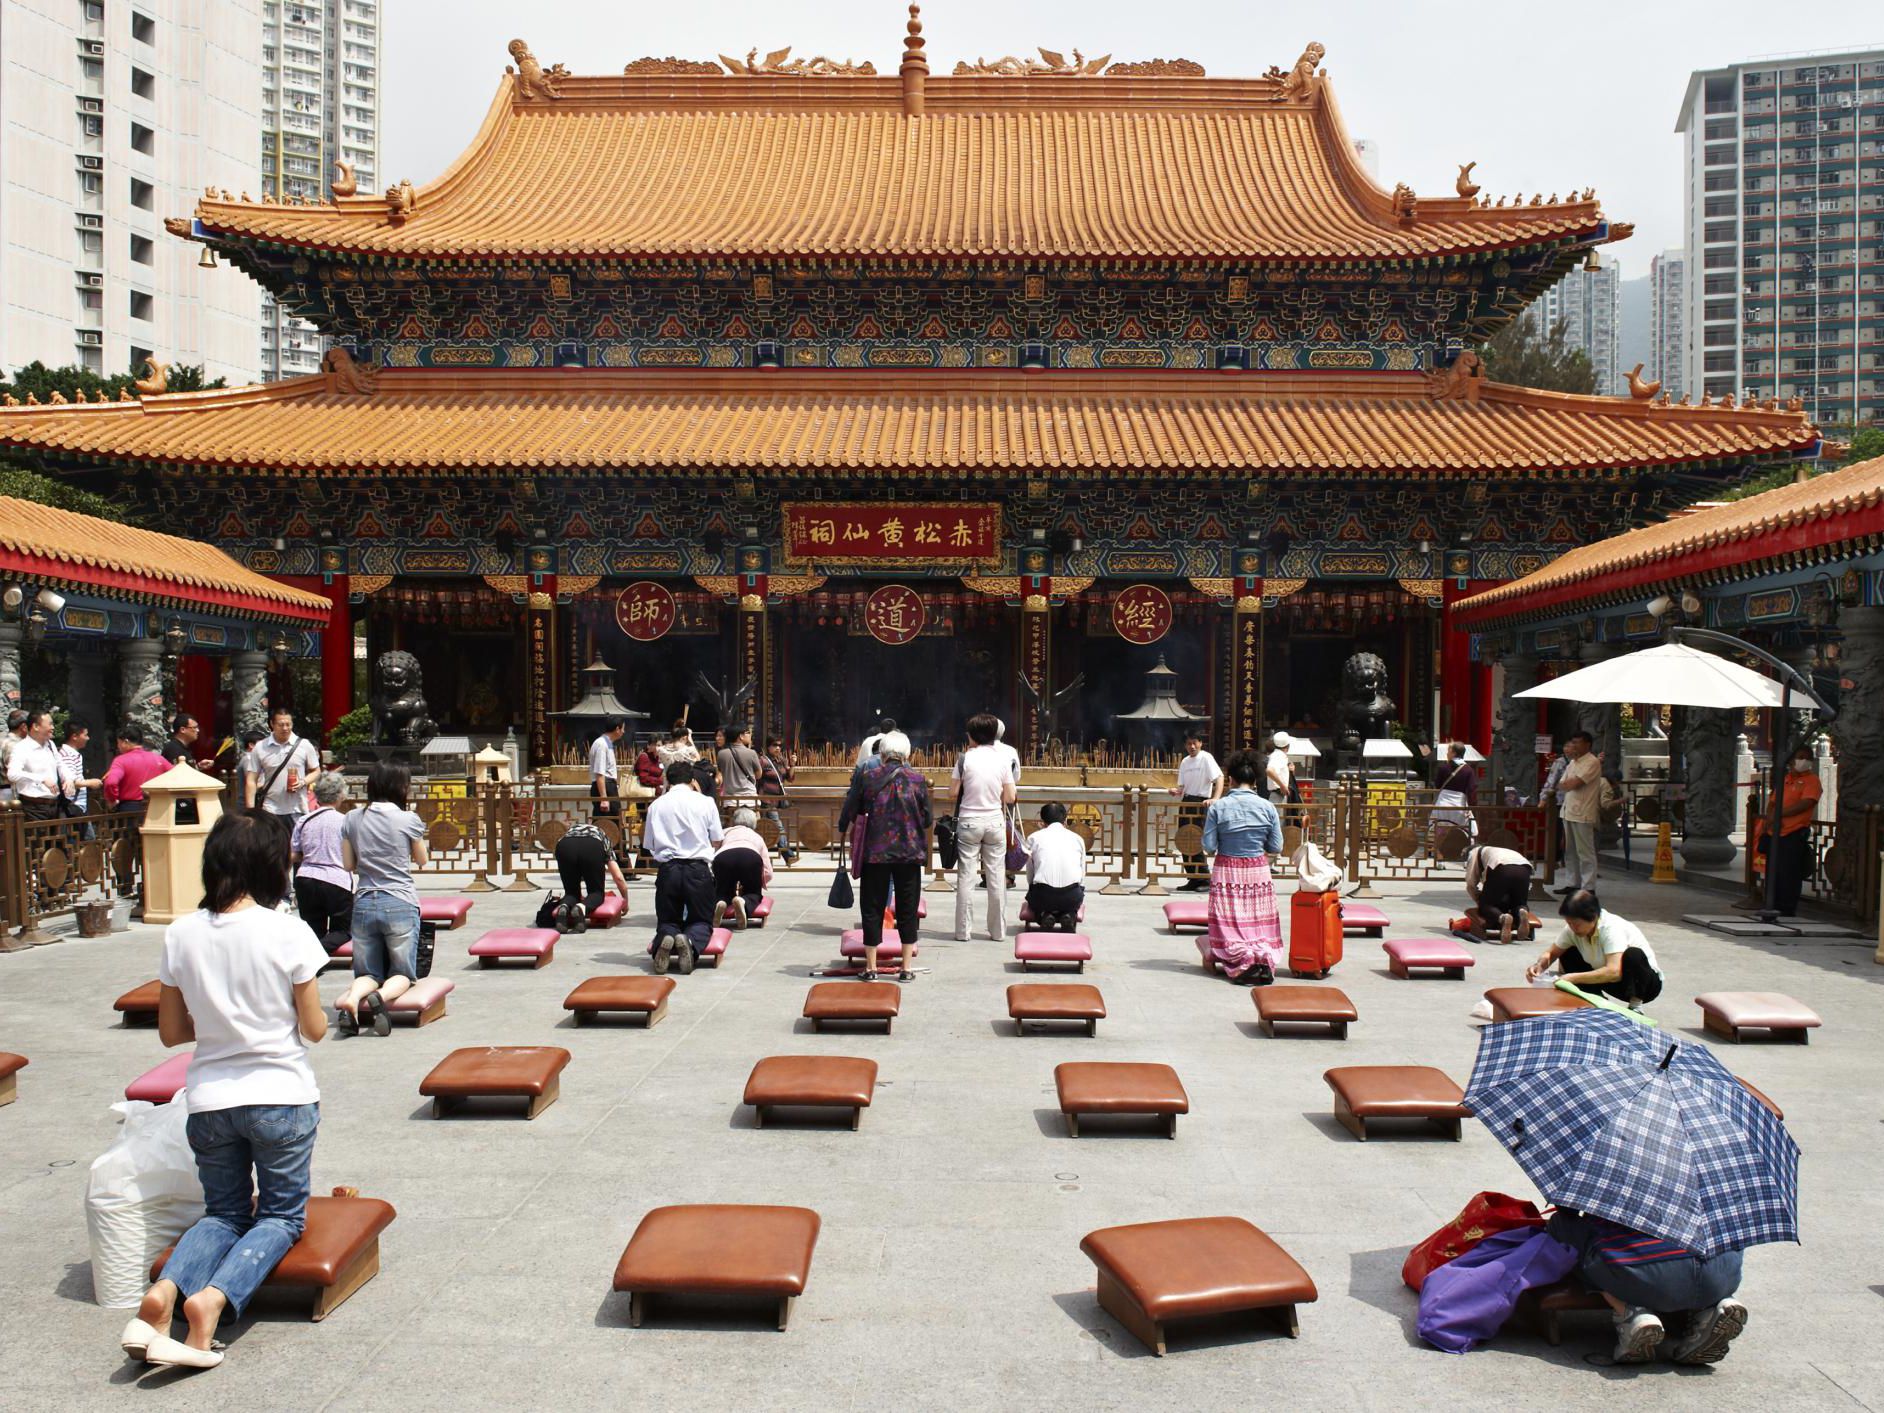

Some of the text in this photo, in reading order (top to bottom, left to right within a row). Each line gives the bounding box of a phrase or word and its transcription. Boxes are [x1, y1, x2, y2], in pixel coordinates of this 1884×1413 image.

[630, 594, 659, 628] 師
[877, 596, 911, 633] 道
[1124, 599, 1156, 629] 經
